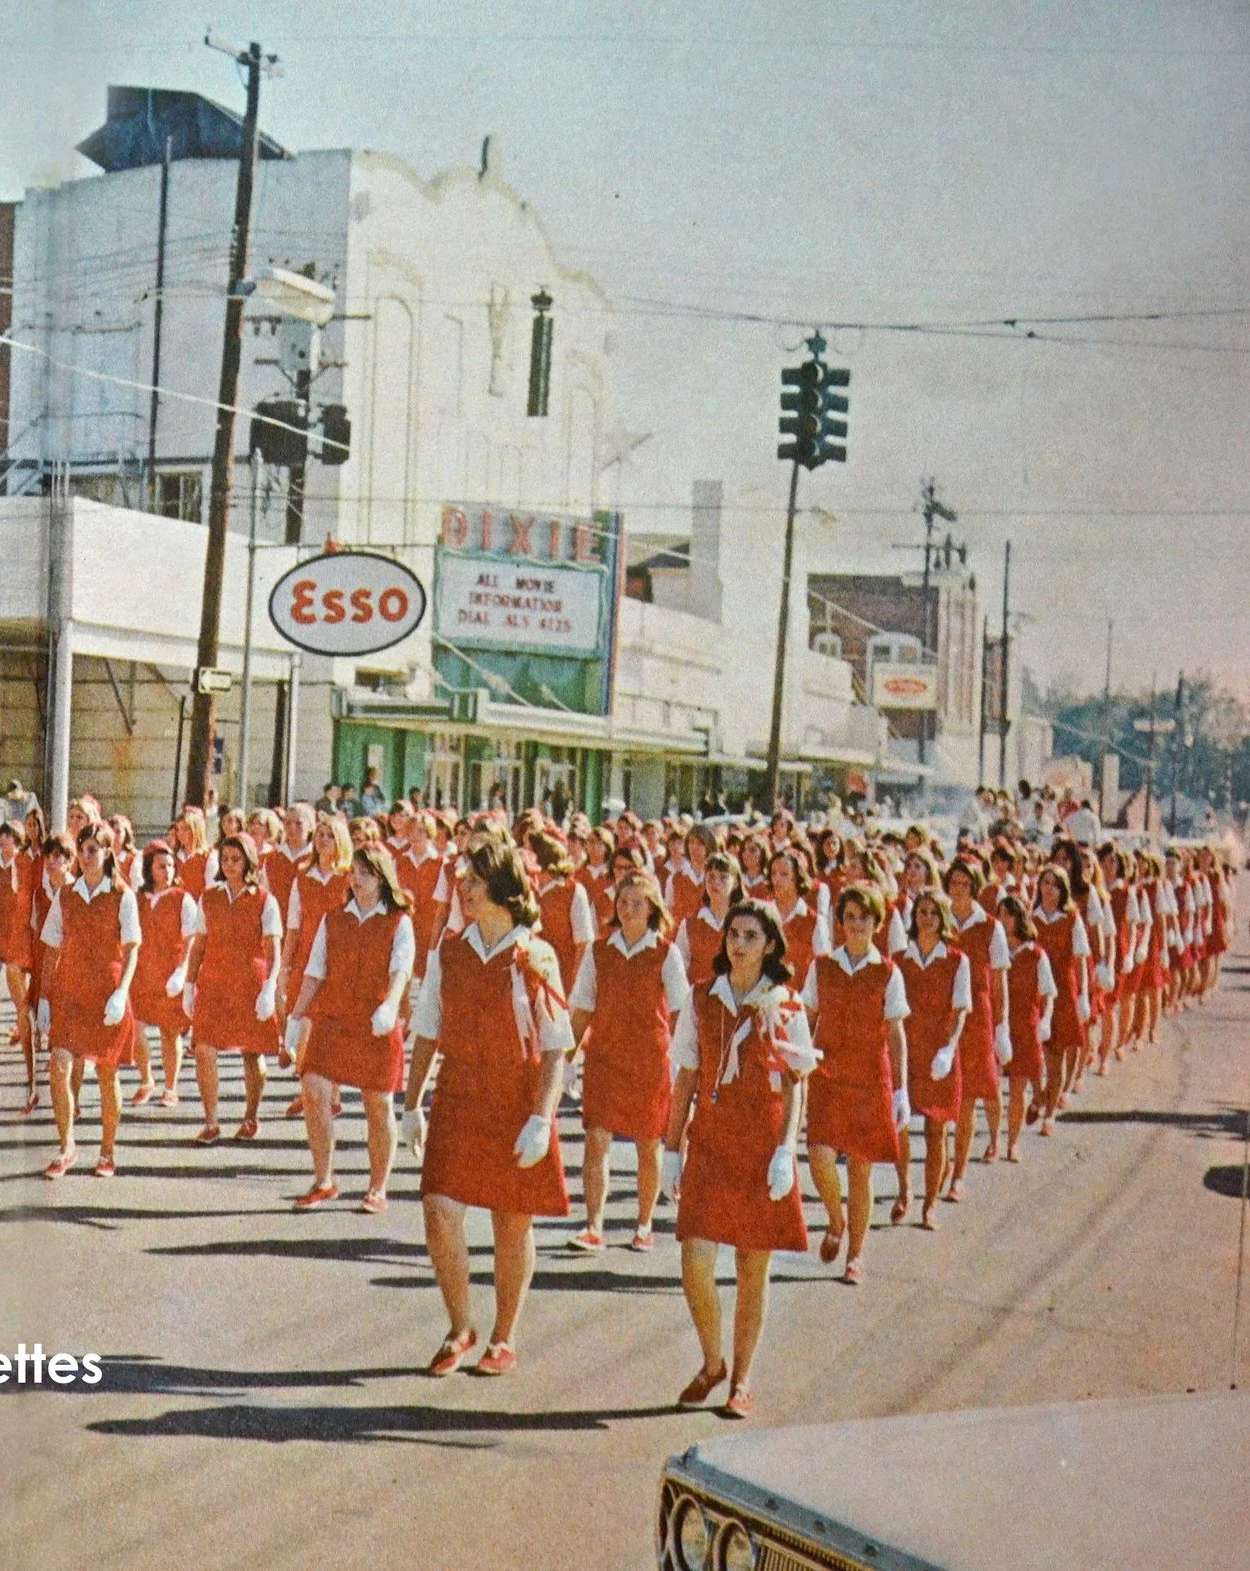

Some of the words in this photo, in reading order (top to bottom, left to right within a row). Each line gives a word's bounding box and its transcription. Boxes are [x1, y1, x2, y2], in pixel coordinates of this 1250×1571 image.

[441, 505, 602, 562] DIXIE
[476, 573, 498, 588] ALL
[516, 577, 555, 593] MOVIE
[469, 591, 563, 613] INFORMATION
[458, 608, 490, 624] DIAL
